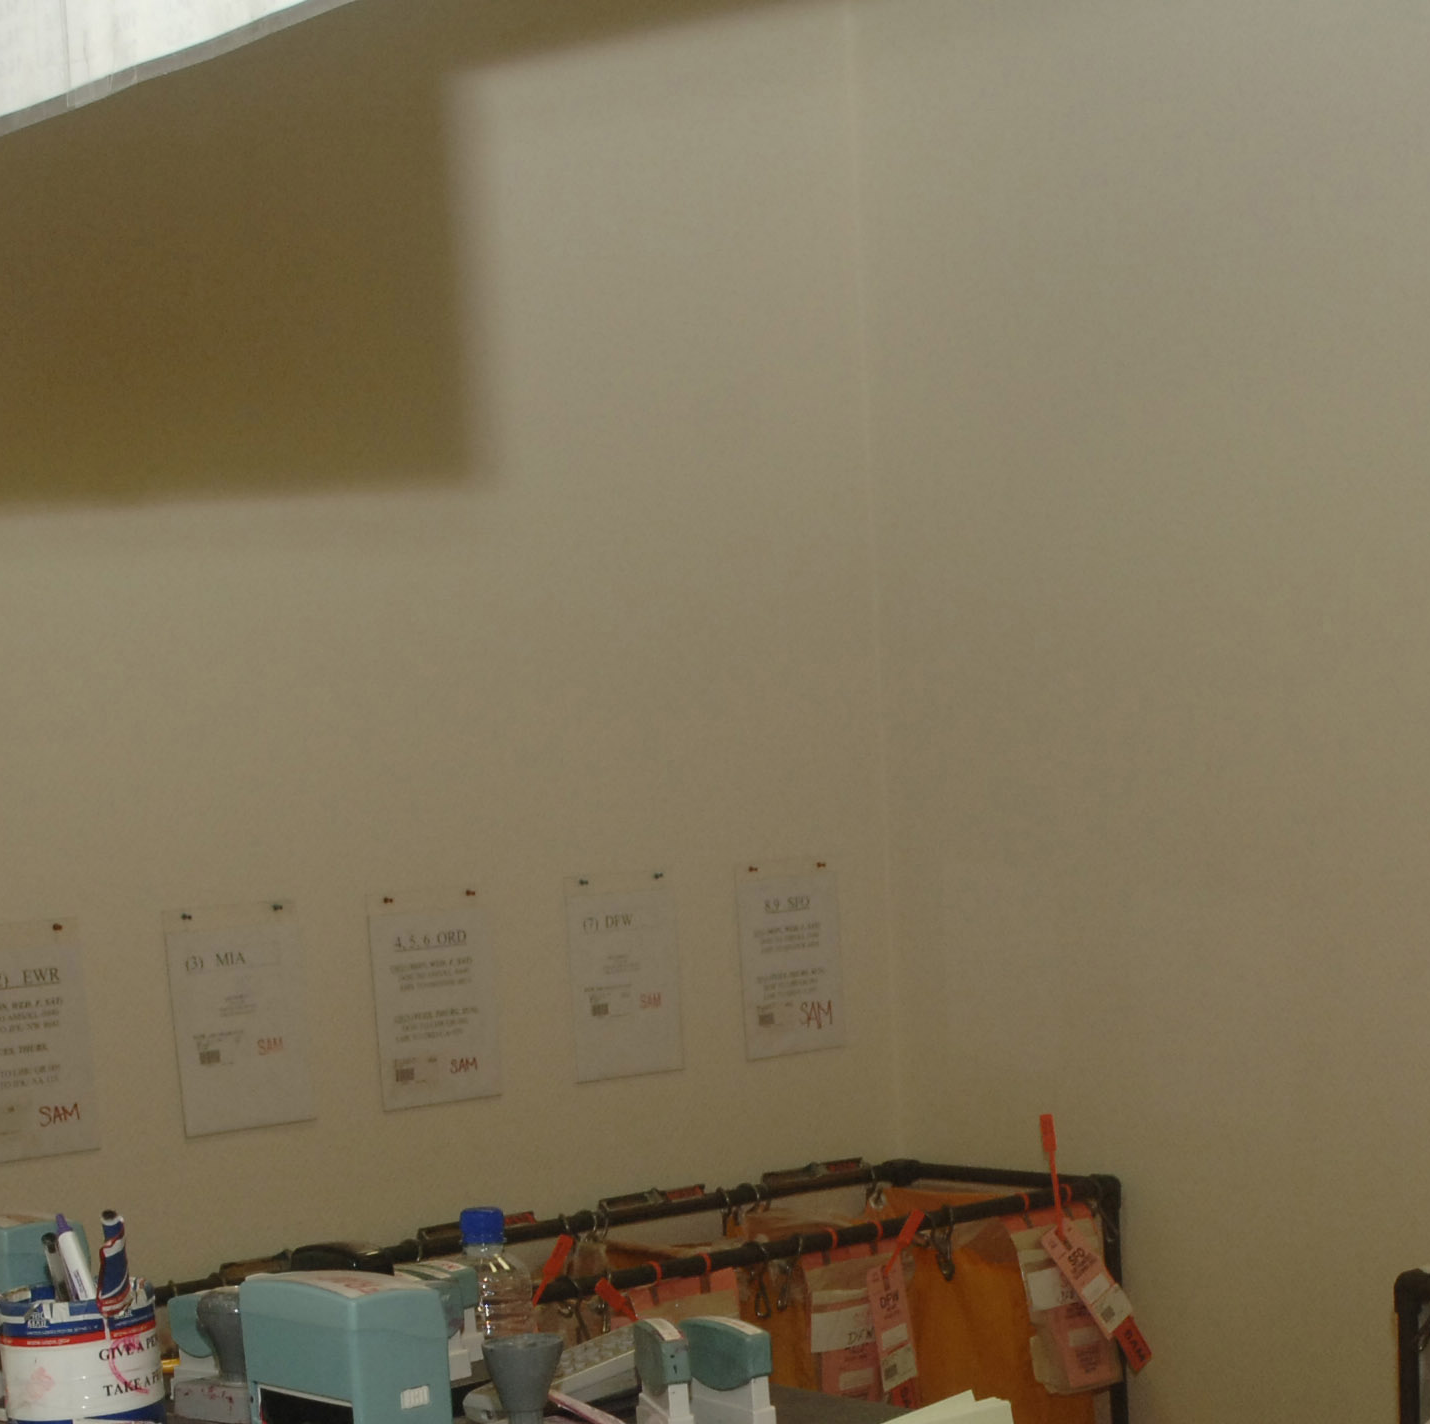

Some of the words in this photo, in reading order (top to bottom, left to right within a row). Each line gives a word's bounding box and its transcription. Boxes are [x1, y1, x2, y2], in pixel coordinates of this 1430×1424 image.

[605, 913, 633, 928] DFW
[437, 930, 467, 945] ORD
[185, 955, 204, 972] (3)
[215, 952, 246, 967] MIA
[22, 967, 60, 984] EWR
[799, 1000, 833, 1029] SAM
[256, 1036, 284, 1056] SAM
[449, 1056, 478, 1074] SAM
[38, 1102, 80, 1128] SAM
[99, 1343, 135, 1362] GIVE
[102, 1378, 143, 1398] TAKE
